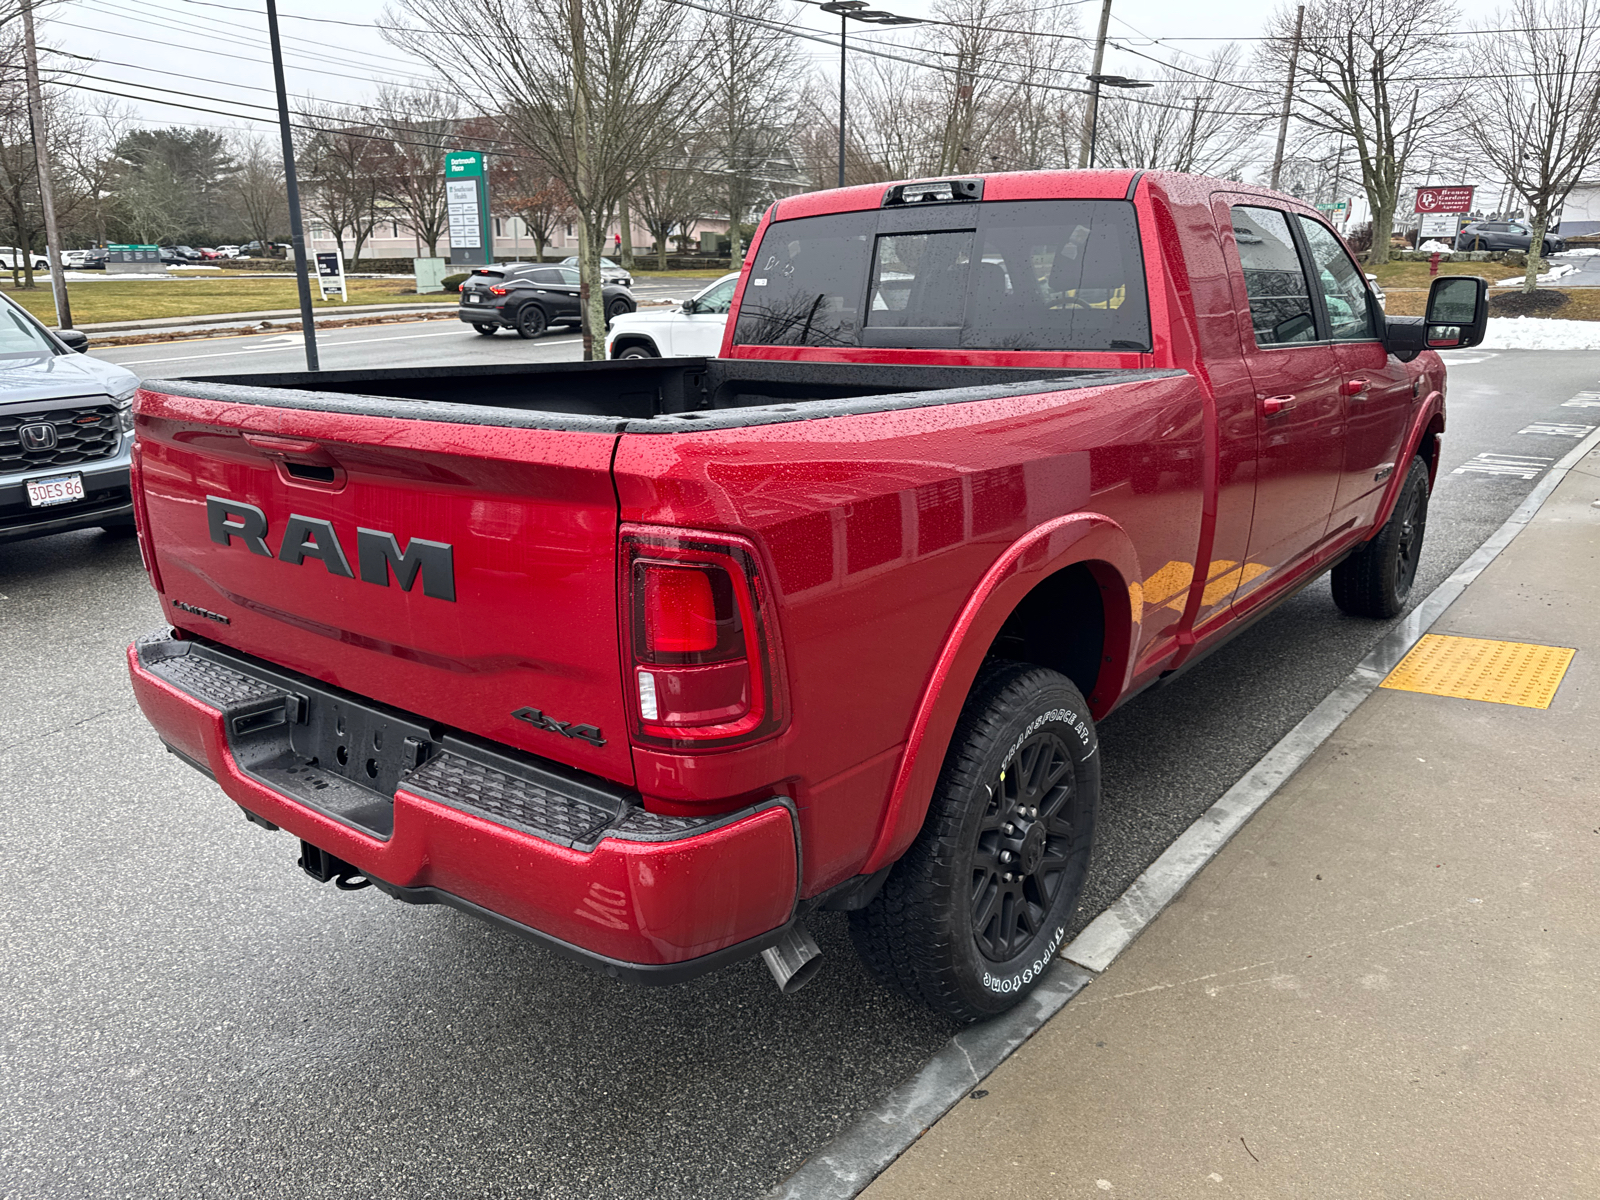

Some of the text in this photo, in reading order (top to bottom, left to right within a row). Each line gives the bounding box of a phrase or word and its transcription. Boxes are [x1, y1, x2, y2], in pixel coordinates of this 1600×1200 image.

[451, 156, 476, 165] Dartmouth
[29, 483, 63, 501] 3DES
[65, 481, 82, 495] 86
[206, 495, 457, 602] RAM
[172, 599, 231, 626] LIMITED
[1001, 708, 1078, 771] TRANSFORCE
